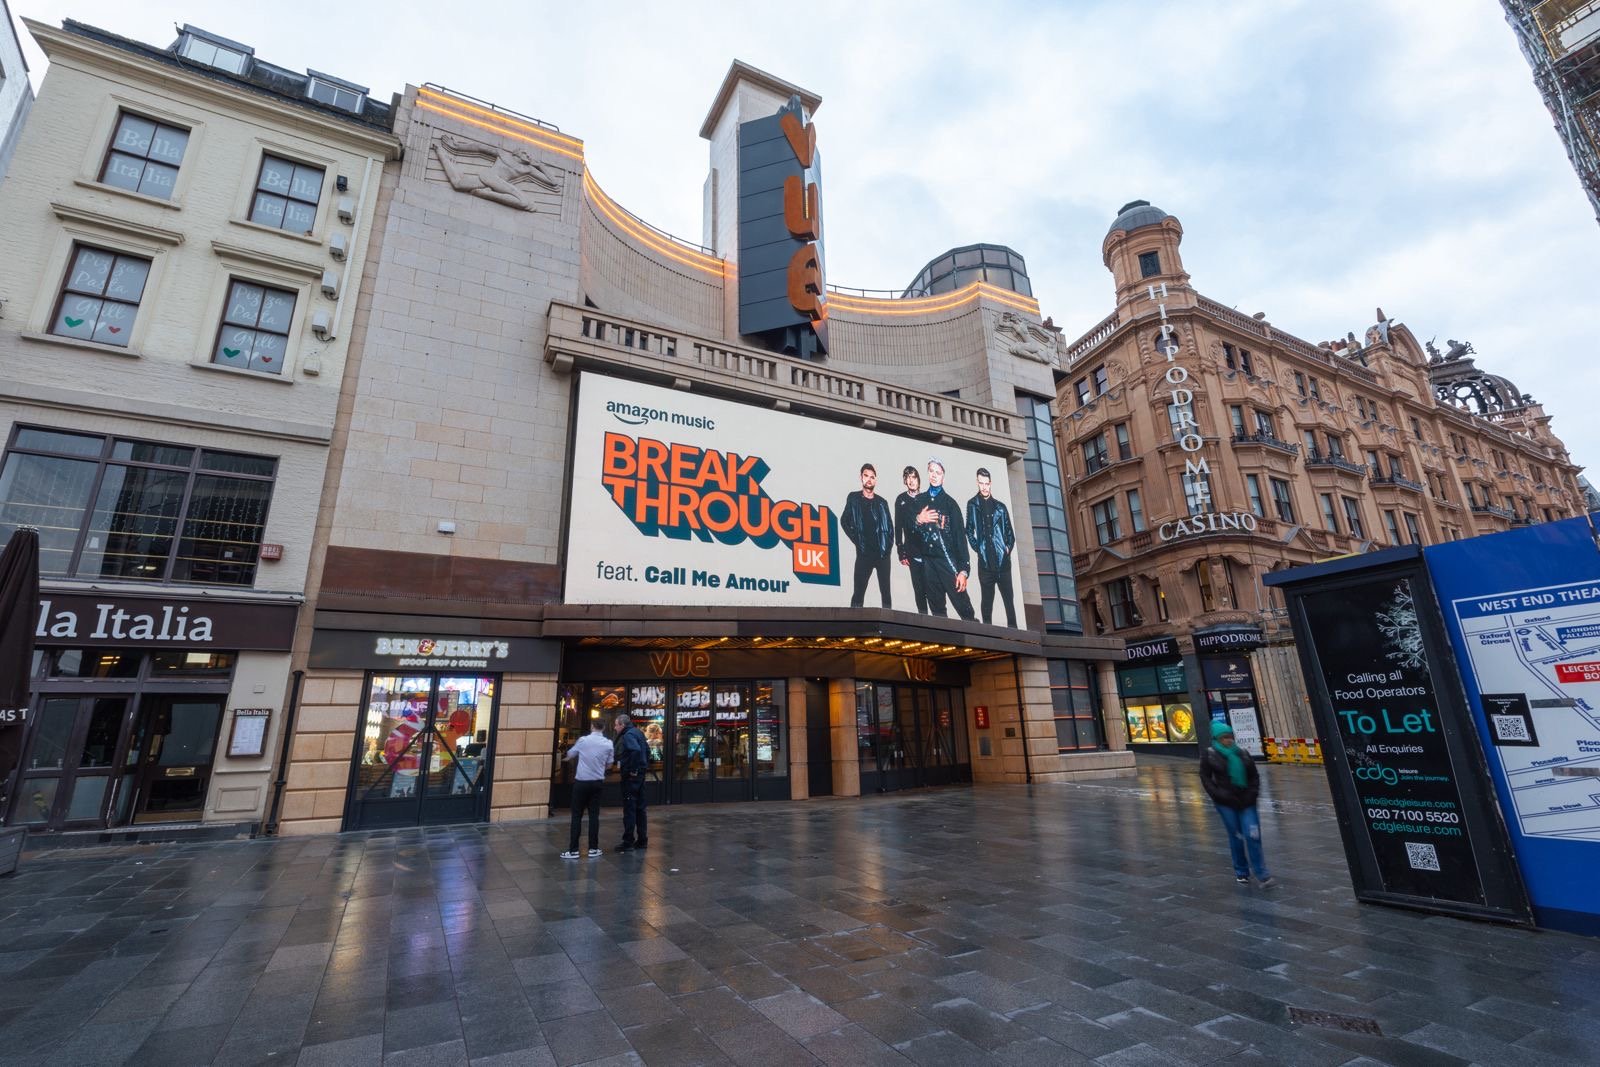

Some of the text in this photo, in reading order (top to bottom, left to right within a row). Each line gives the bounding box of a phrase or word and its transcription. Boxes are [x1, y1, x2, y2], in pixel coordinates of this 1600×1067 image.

[119, 128, 180, 158] Bella
[109, 156, 171, 187] Italia
[262, 168, 317, 196] Bella
[256, 197, 310, 223] Italia
[1147, 282, 1211, 498] HIPPODROME
[606, 401, 715, 430] amazon music
[603, 431, 762, 496] BREAK
[602, 475, 829, 545] THROUGH
[1159, 511, 1257, 541] CASINO
[797, 548, 825, 568] UK
[596, 561, 790, 594] feat. Call Me Amour
[1478, 598, 1517, 612] WEST
[1521, 594, 1555, 607] END
[90, 603, 213, 642] Italia
[1199, 633, 1261, 647] HIPPODROME
[1480, 632, 1511, 640] Oxford
[1480, 638, 1511, 646] Circus
[1347, 670, 1403, 684] Calling all
[1335, 686, 1426, 700] Food Operators
[1338, 708, 1436, 735] To Let
[1366, 744, 1424, 755] All Enquiries
[1356, 763, 1398, 786] cdg
[1364, 796, 1456, 809] info@cdgleisure.com
[1368, 808, 1459, 824] 020 7100 5520
[1372, 821, 1462, 836] cdgleisure.com
